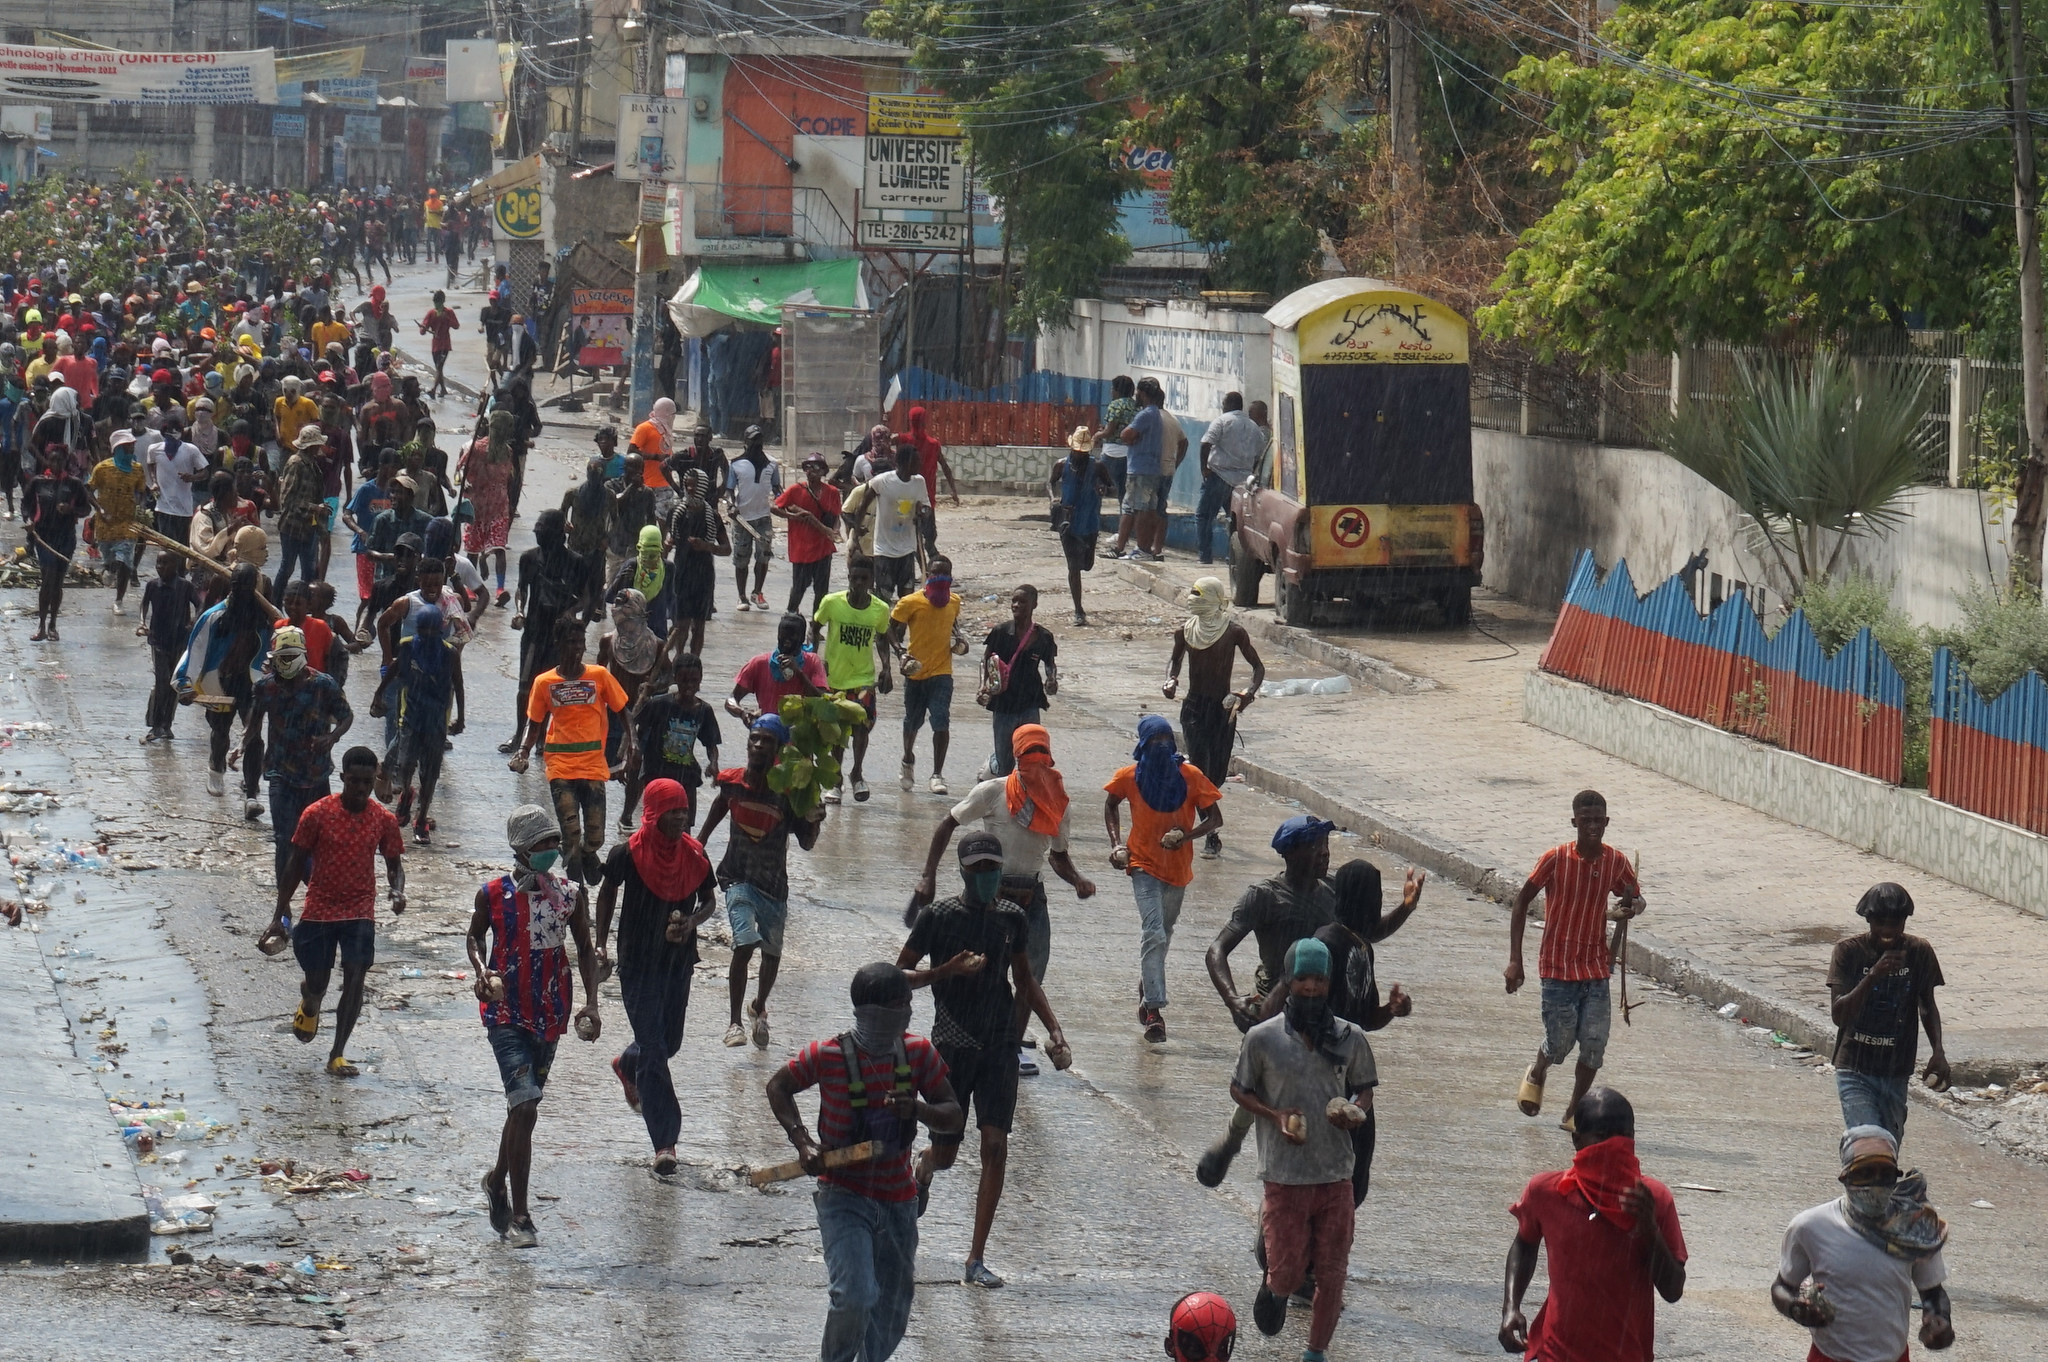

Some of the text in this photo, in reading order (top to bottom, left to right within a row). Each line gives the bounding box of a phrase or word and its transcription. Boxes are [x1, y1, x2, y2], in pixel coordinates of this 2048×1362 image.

[119, 54, 216, 65] (UNITECH)
[19, 62, 48, 72] session
[55, 63, 97, 74] Novembre
[185, 65, 250, 75] Agronomie
[177, 79, 251, 87] Topographie
[631, 103, 677, 115] BAKARA
[878, 107, 910, 118] Sciences
[797, 117, 857, 137] COPIE
[903, 119, 925, 129] Civil
[878, 164, 950, 190] LUMIERE
[880, 194, 949, 204] carrefour
[1180, 331, 1191, 370] DE
[1194, 331, 1244, 377] CARREFOUR
[840, 632, 870, 652] PARK
[1853, 1031, 1895, 1046] AWESOME
